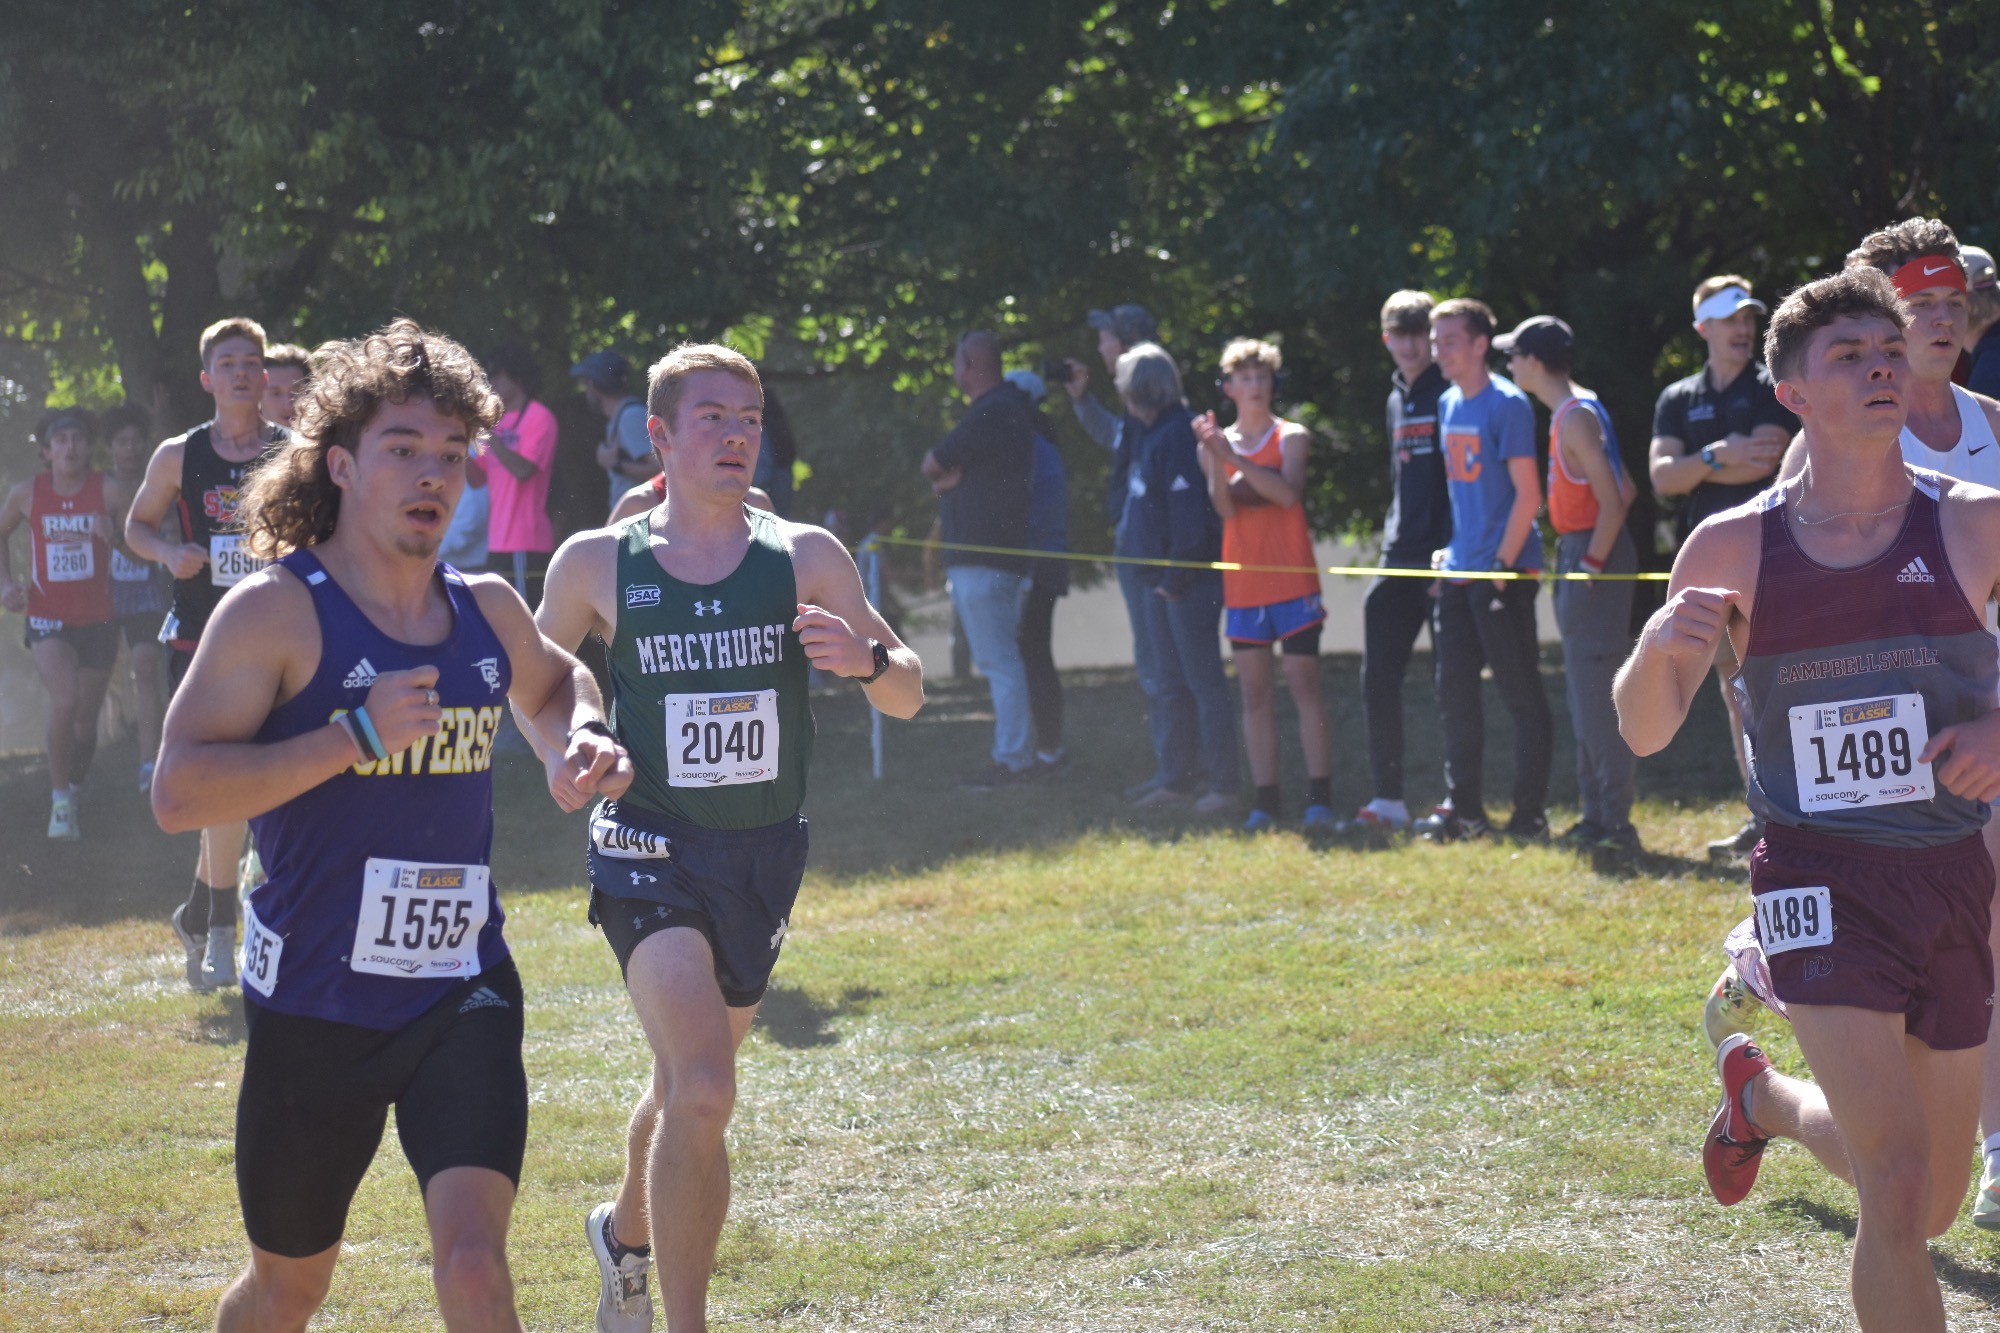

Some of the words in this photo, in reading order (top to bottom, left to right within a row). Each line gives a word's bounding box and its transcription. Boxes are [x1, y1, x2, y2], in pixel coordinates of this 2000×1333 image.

[43, 514, 95, 537] RMU
[53, 554, 87, 573] 2260
[1897, 572, 1935, 583] adidas
[627, 590, 659, 603] PSAC
[636, 624, 785, 674] MERCYHURST
[342, 675, 375, 688] adid
[711, 702, 753, 713] CLASSIC
[1823, 708, 1837, 716] live
[1842, 705, 1863, 714] CROSS
[1864, 700, 1892, 711] COUNTRY
[1842, 707, 1891, 724] CLASSIC
[682, 719, 764, 765] 2040
[1809, 727, 1912, 785] 1489
[681, 771, 719, 779] saucony
[1815, 790, 1859, 801] saucony
[419, 876, 462, 888] CLASSIC
[374, 895, 472, 950] 1555
[1762, 895, 1819, 944] 1489
[247, 916, 272, 980] 55
[369, 955, 416, 968] saucony
[459, 998, 510, 1013] adidas
